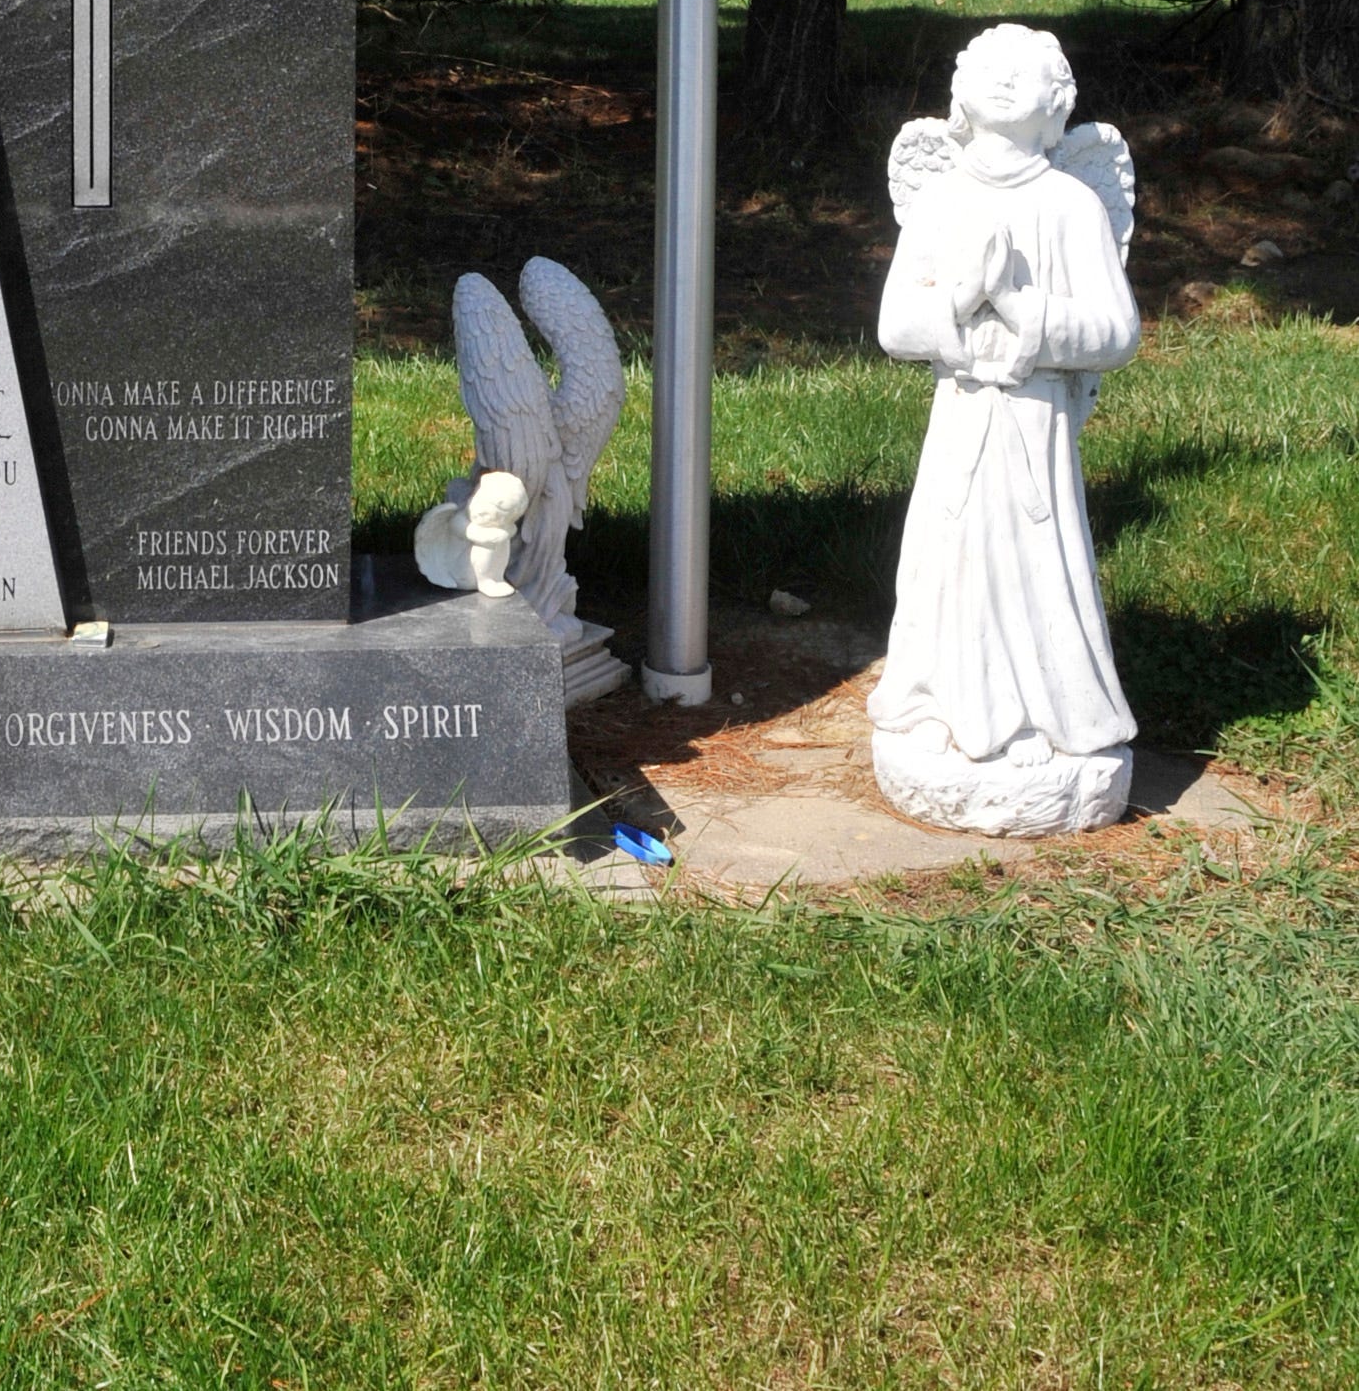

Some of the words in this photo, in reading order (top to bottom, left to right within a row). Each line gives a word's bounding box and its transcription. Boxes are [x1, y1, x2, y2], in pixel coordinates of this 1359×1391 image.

[50, 378, 115, 407] ONNA
[123, 380, 181, 407] MAKE
[190, 381, 204, 406] A
[85, 416, 158, 441] GONNA
[167, 415, 225, 441] MAKE
[233, 415, 254, 440] IT
[236, 529, 331, 555] FOREVER
[136, 564, 234, 591] MICHAEL
[243, 563, 340, 590] JACKSON
[224, 707, 353, 744] WISDOM
[383, 704, 483, 741] SPIRIT
